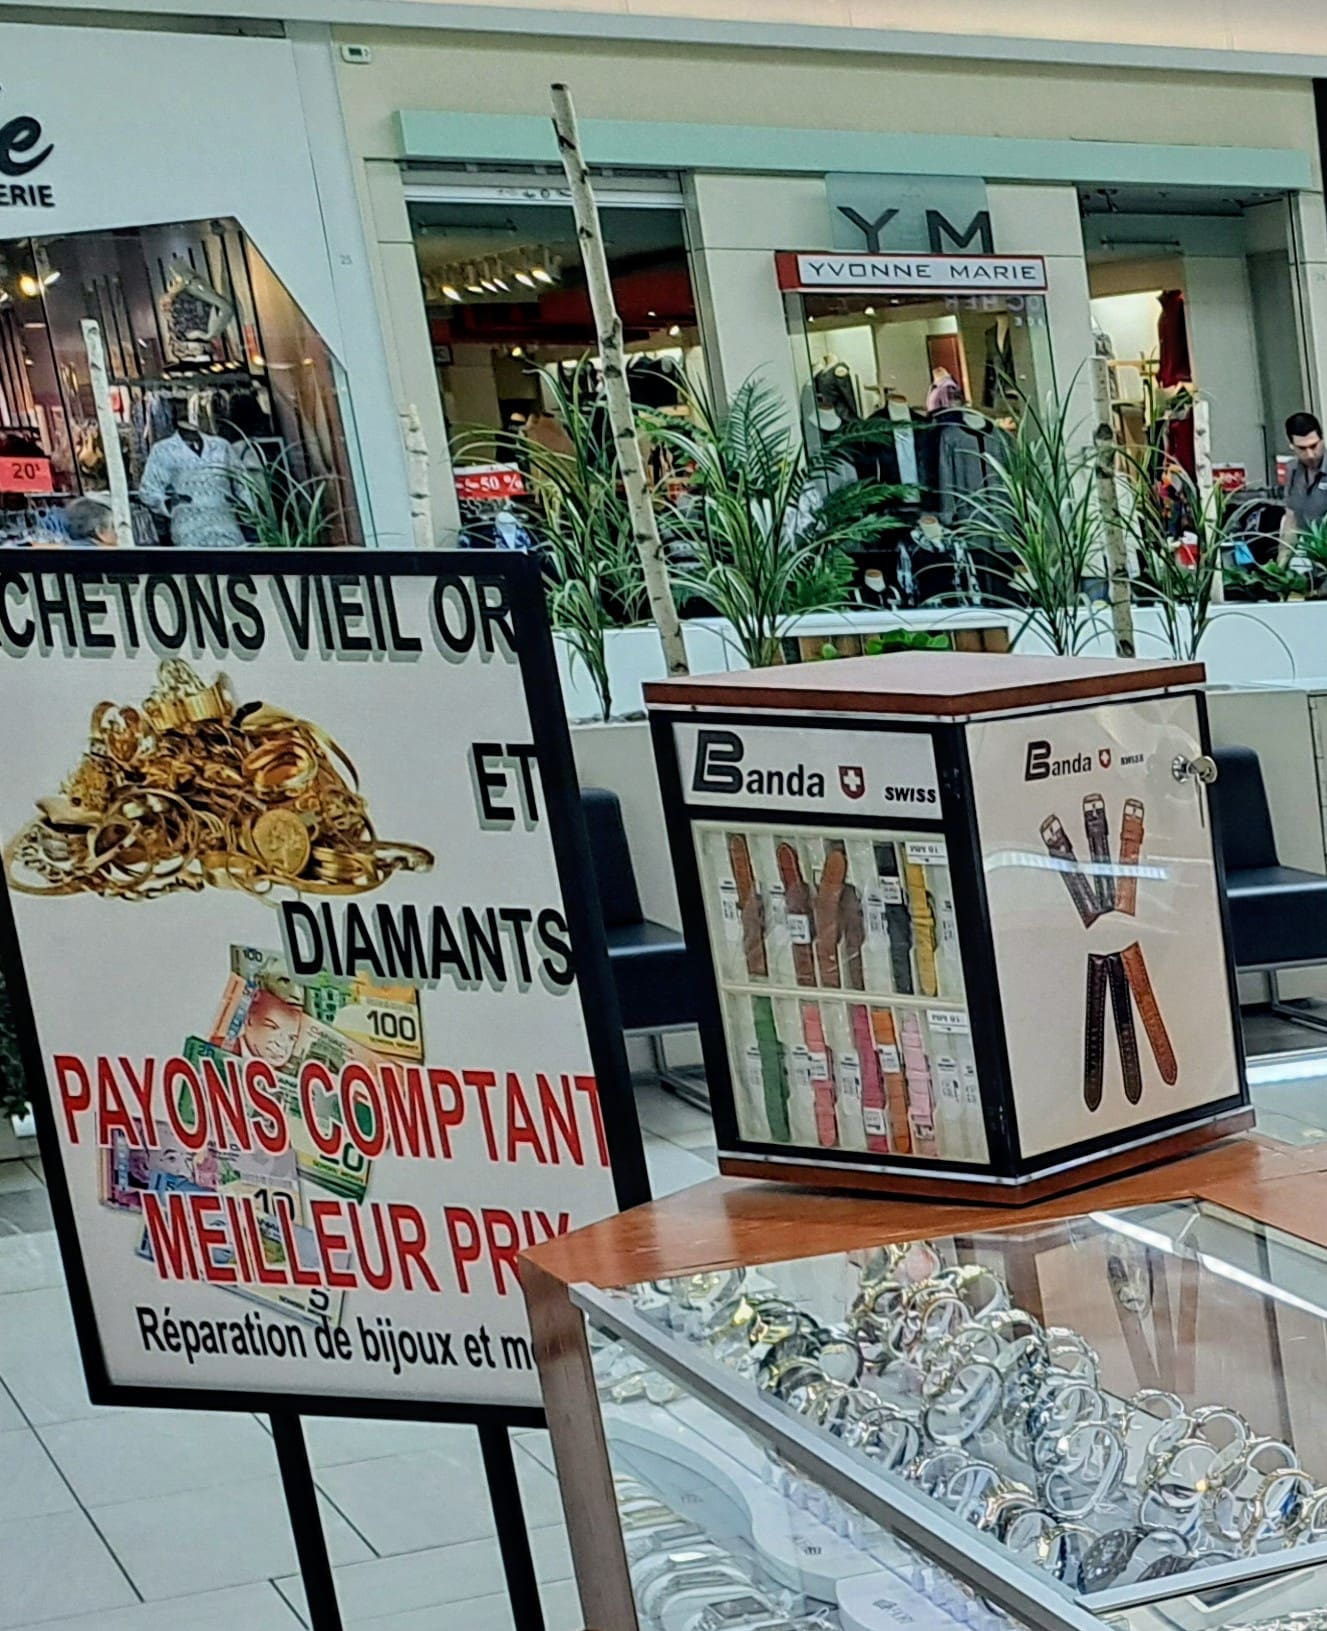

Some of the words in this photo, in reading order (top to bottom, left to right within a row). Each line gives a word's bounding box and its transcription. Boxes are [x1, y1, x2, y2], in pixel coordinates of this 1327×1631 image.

[809, 263, 931, 278] YVONNE
[951, 265, 1036, 279] MARIE
[280, 574, 422, 652] VIEIL
[434, 574, 519, 654] OR
[472, 743, 539, 822] ET
[692, 730, 825, 798] Banda
[884, 785, 937, 803] SWISS
[1024, 740, 1092, 781] Banda
[281, 901, 577, 985] DIAMANTS
[367, 1010, 417, 1042] 100
[54, 1055, 290, 1153] PAYONS
[300, 1062, 610, 1167] COMPTANT
[142, 1193, 440, 1292] MEILLEUR
[136, 1305, 301, 1363] Réparation
[314, 1315, 352, 1361] de
[359, 1317, 458, 1374] bijoux
[464, 1324, 496, 1368] et
[501, 1336, 536, 1371] m
